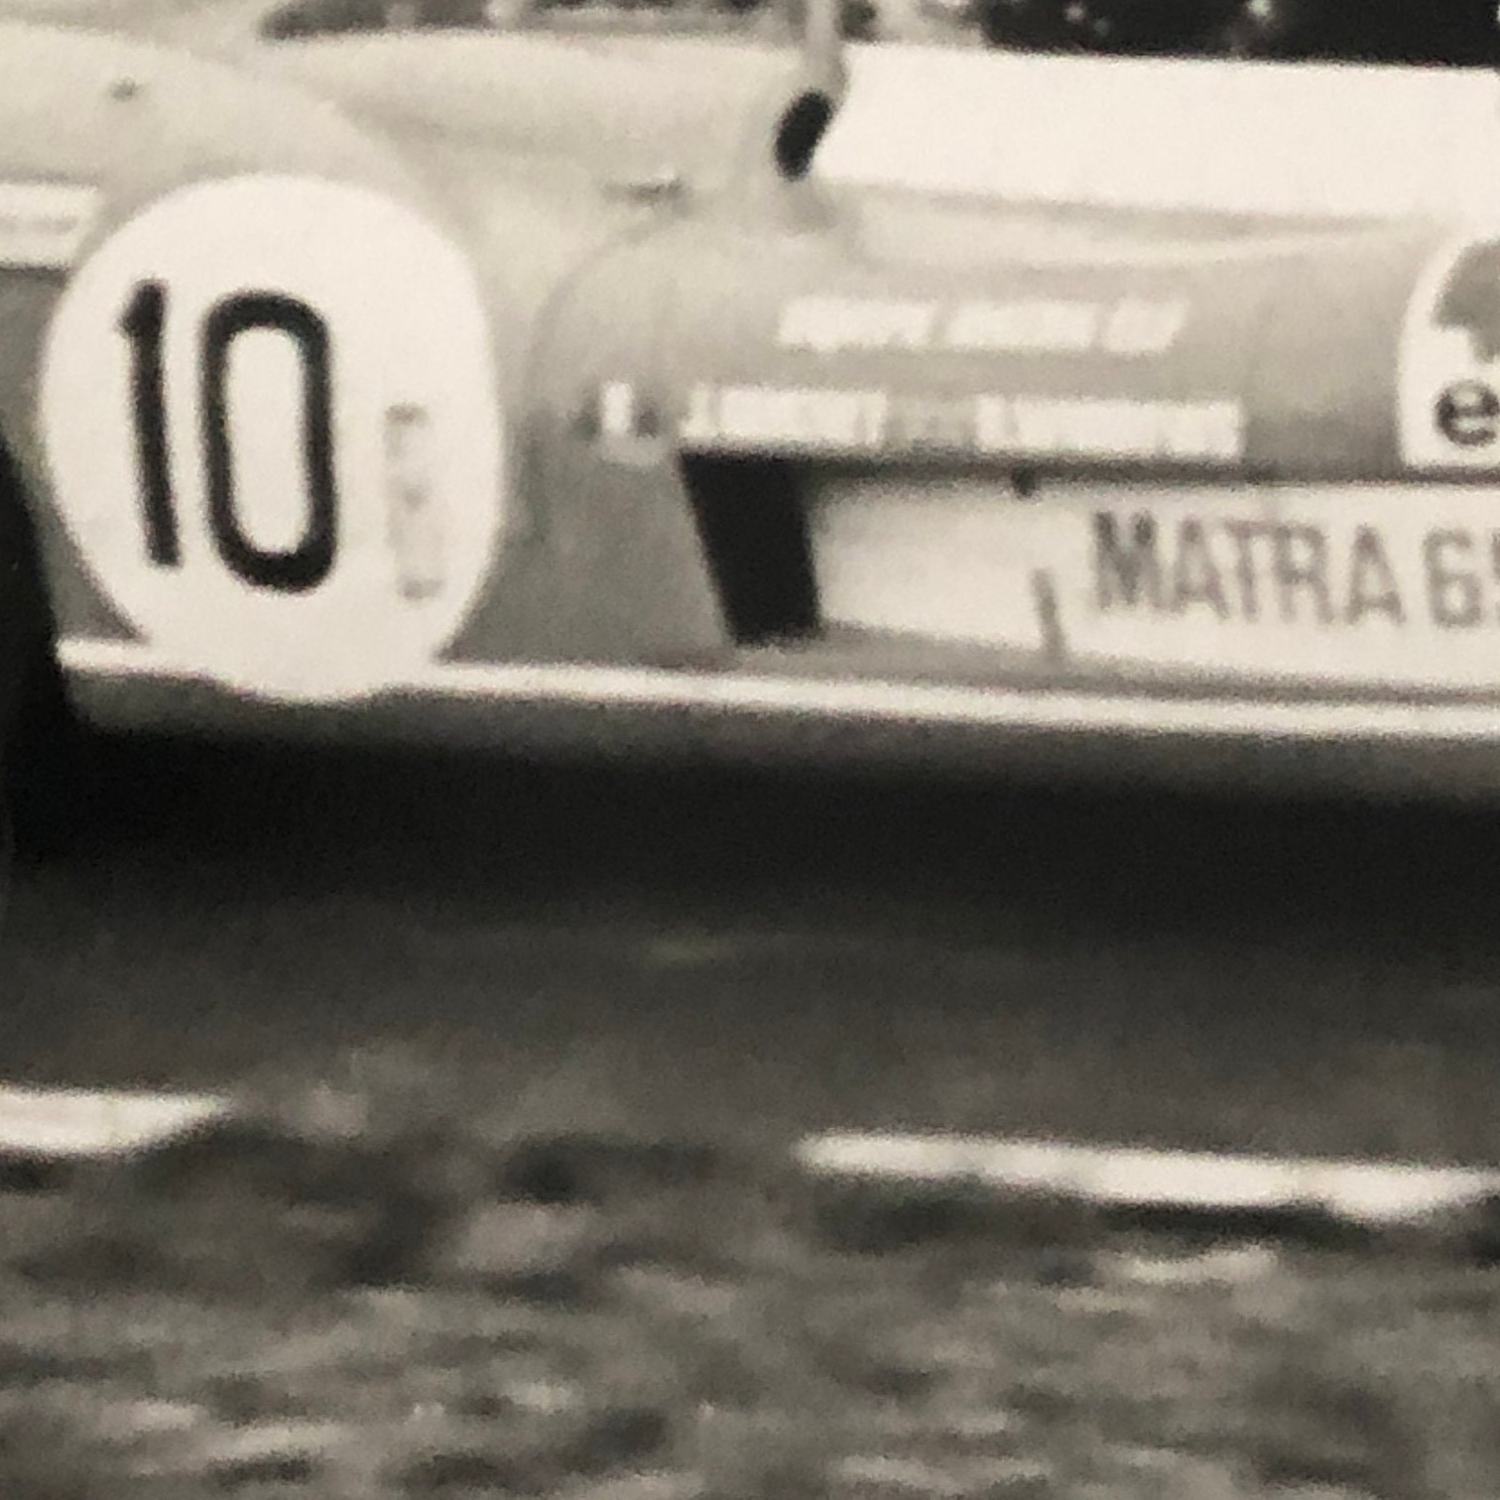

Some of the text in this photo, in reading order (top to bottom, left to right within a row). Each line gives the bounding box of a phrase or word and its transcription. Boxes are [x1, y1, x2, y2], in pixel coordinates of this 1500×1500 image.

[120, 277, 338, 595] 10
[1092, 510, 1500, 630] MATRA 6
